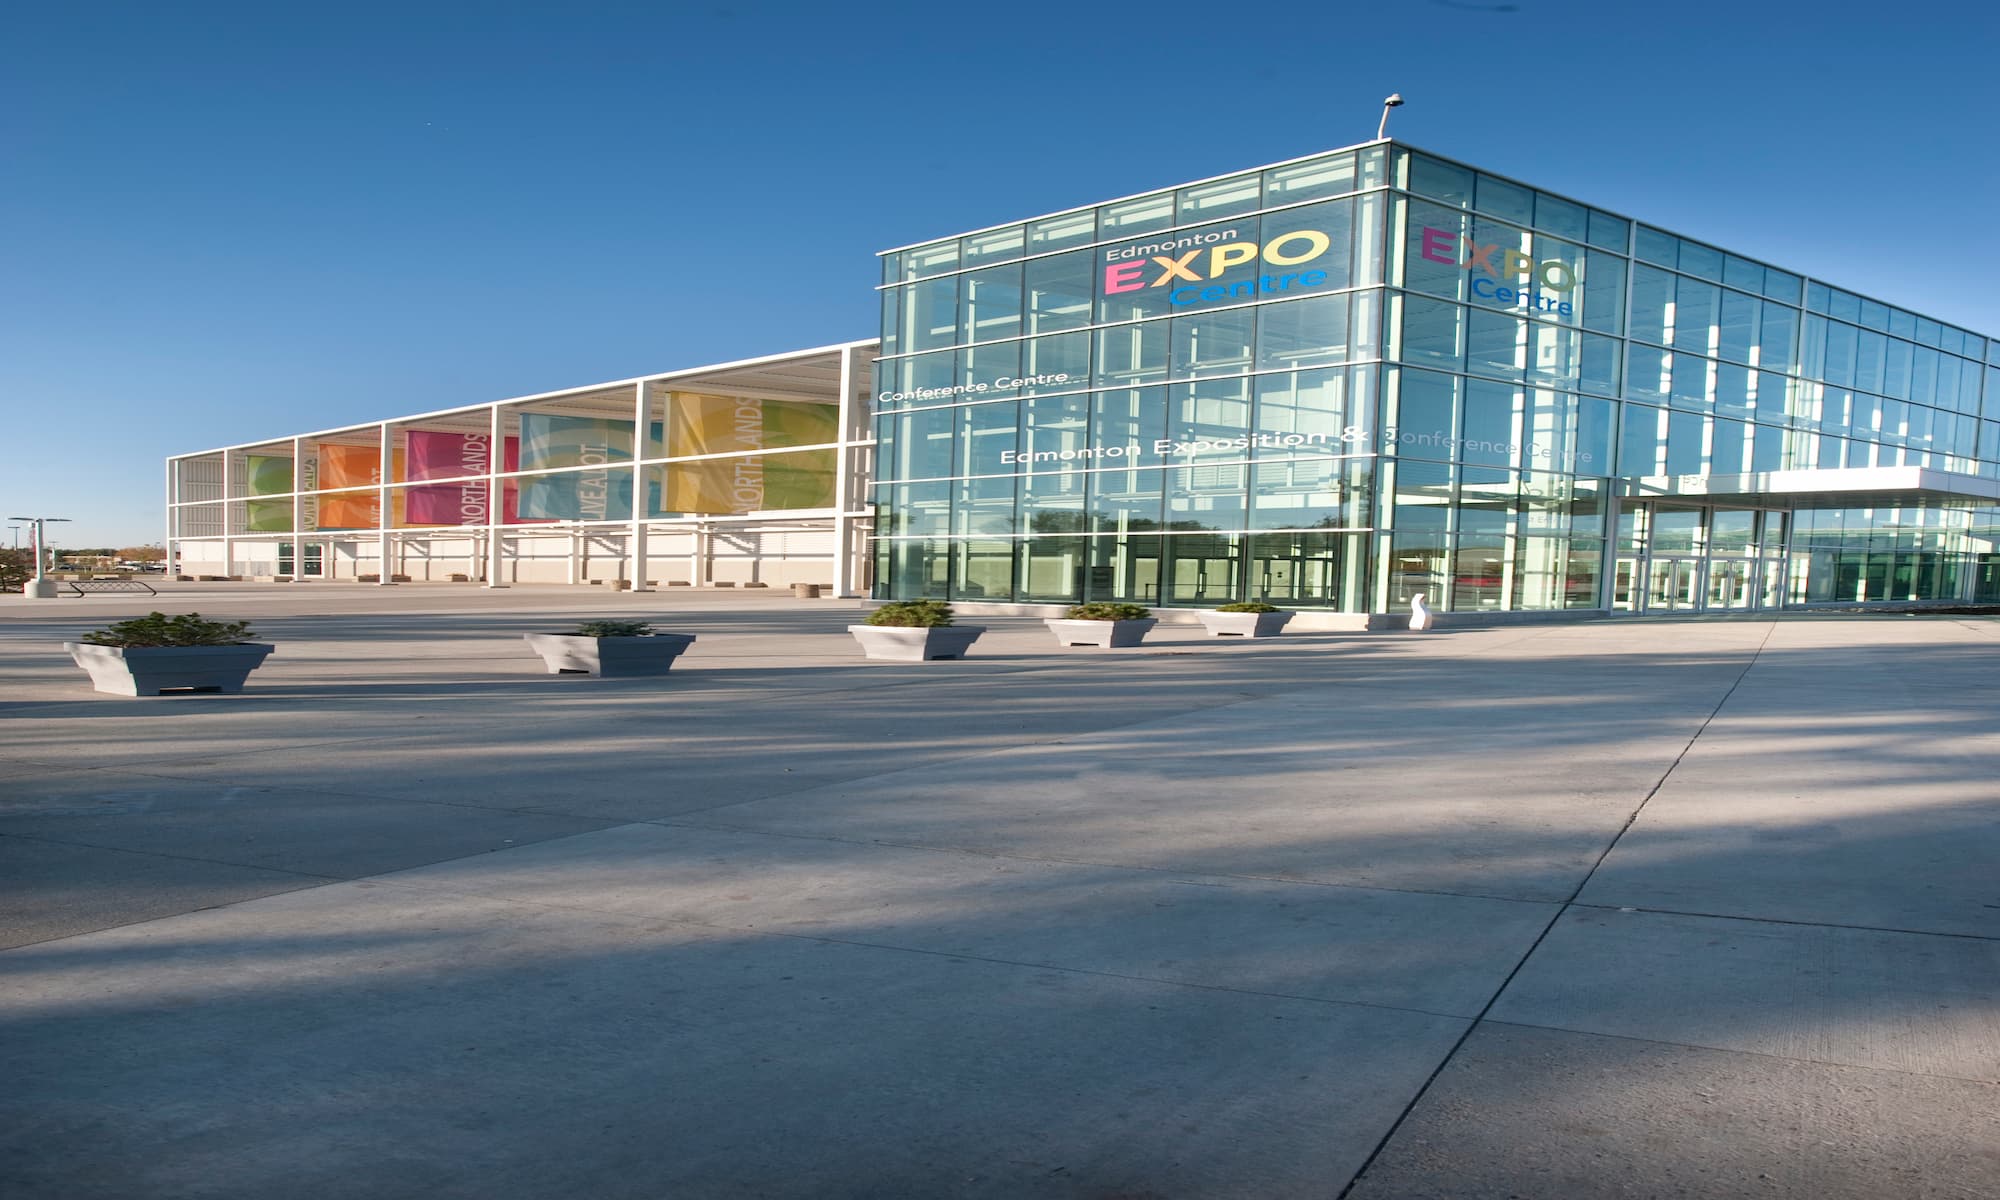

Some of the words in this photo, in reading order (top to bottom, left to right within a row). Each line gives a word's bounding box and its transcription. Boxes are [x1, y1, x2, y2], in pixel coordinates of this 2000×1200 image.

[1104, 230, 1330, 295] EXPO
[1106, 229, 1237, 261] Edmonton
[1422, 226, 1576, 292] EXPO
[1169, 269, 1327, 305] Centre
[1472, 278, 1573, 316] Centre
[879, 382, 988, 403] Conference
[995, 373, 1068, 389] Centre
[1000, 445, 1141, 465] Edmonton
[1153, 431, 1326, 456] Exposition
[1341, 425, 1368, 442] &
